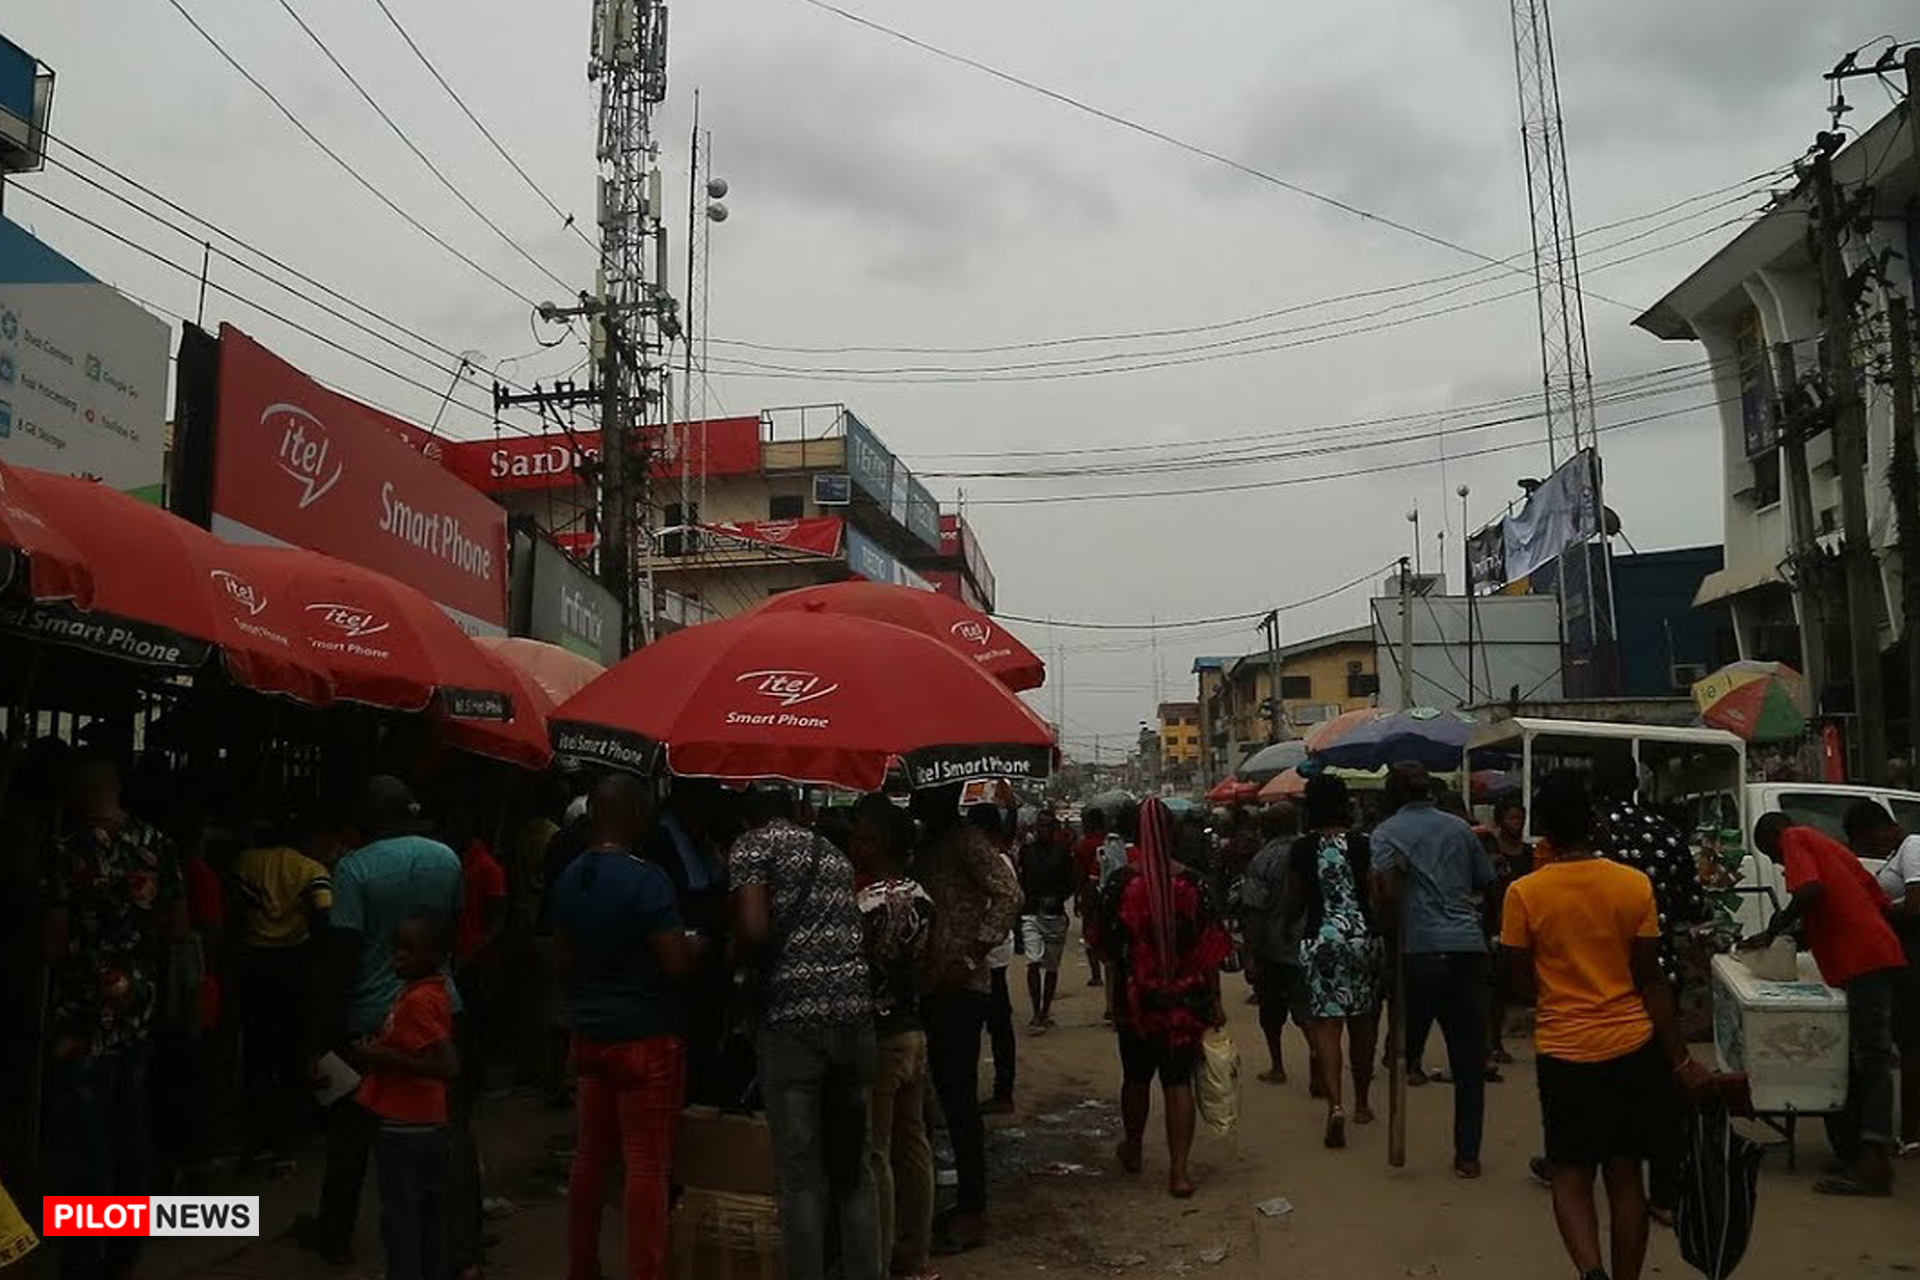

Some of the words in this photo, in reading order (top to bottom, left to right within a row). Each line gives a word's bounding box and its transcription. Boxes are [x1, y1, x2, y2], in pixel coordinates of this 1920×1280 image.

[280, 419, 329, 476] itel
[490, 446, 602, 477] SanDis
[380, 481, 441, 555] Smart
[440, 515, 493, 580] Phone
[225, 577, 255, 602] itel
[325, 608, 373, 628] itel
[109, 627, 180, 662] Phone
[758, 674, 819, 693] itel
[726, 711, 776, 726] Smart
[777, 713, 830, 728] Phone
[941, 756, 989, 779] Smart
